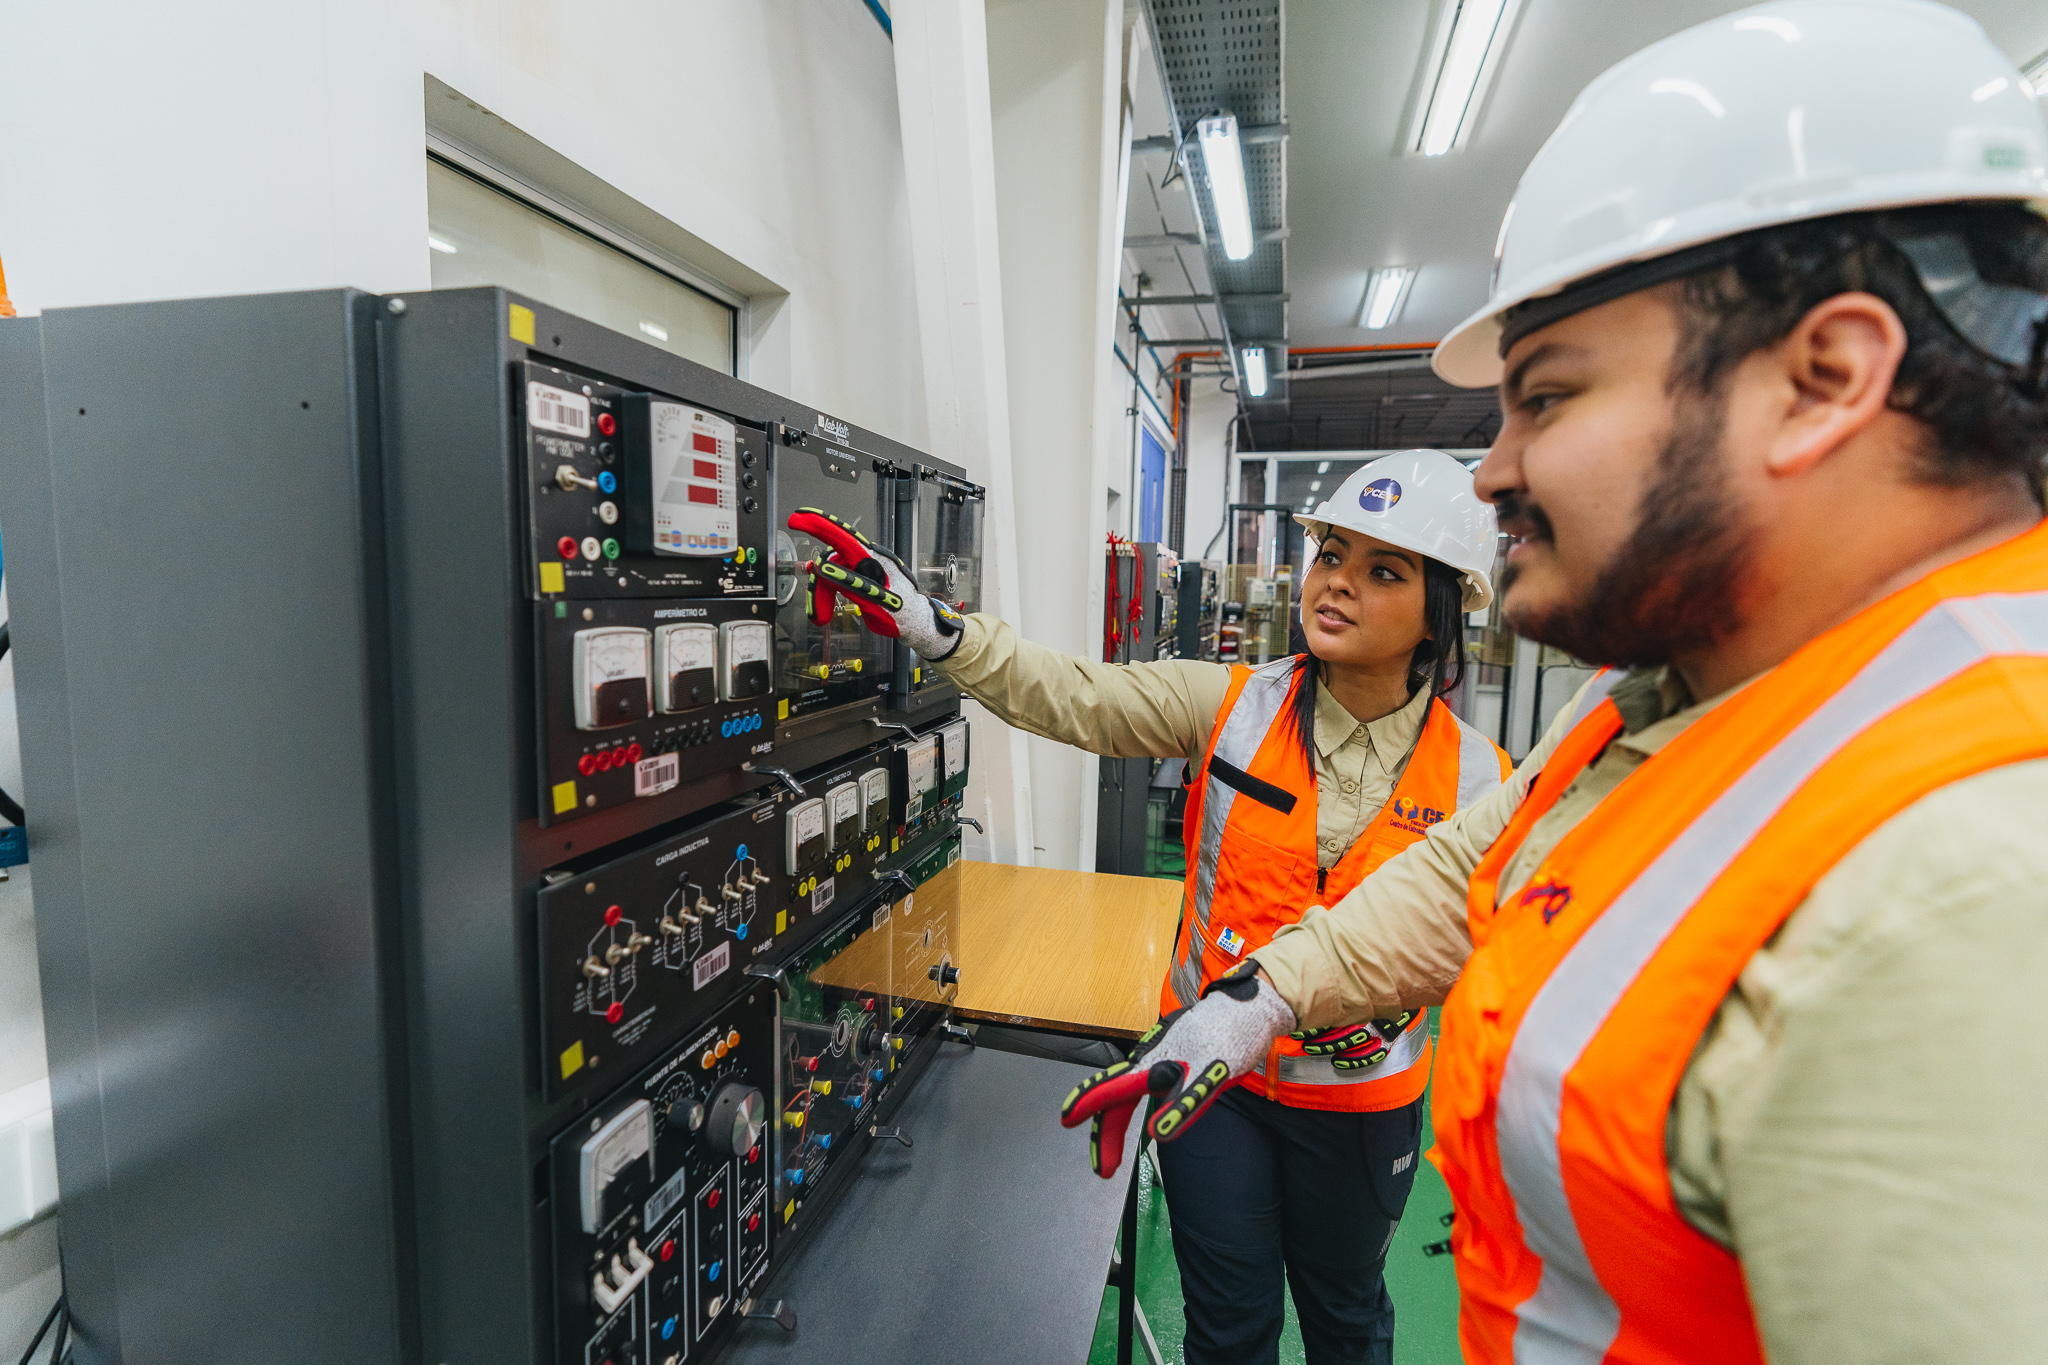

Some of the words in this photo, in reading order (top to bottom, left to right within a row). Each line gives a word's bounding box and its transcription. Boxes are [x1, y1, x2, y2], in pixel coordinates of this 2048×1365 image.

[698, 608, 708, 617] CA
[655, 849, 678, 867] CARGA
[678, 837, 710, 856] INDUCTIVA
[644, 1064, 669, 1091] FUENTE
[669, 1057, 679, 1071] DE
[678, 1025, 719, 1063] ALIMENTACIÓN
[1391, 1150, 1414, 1176] HW
